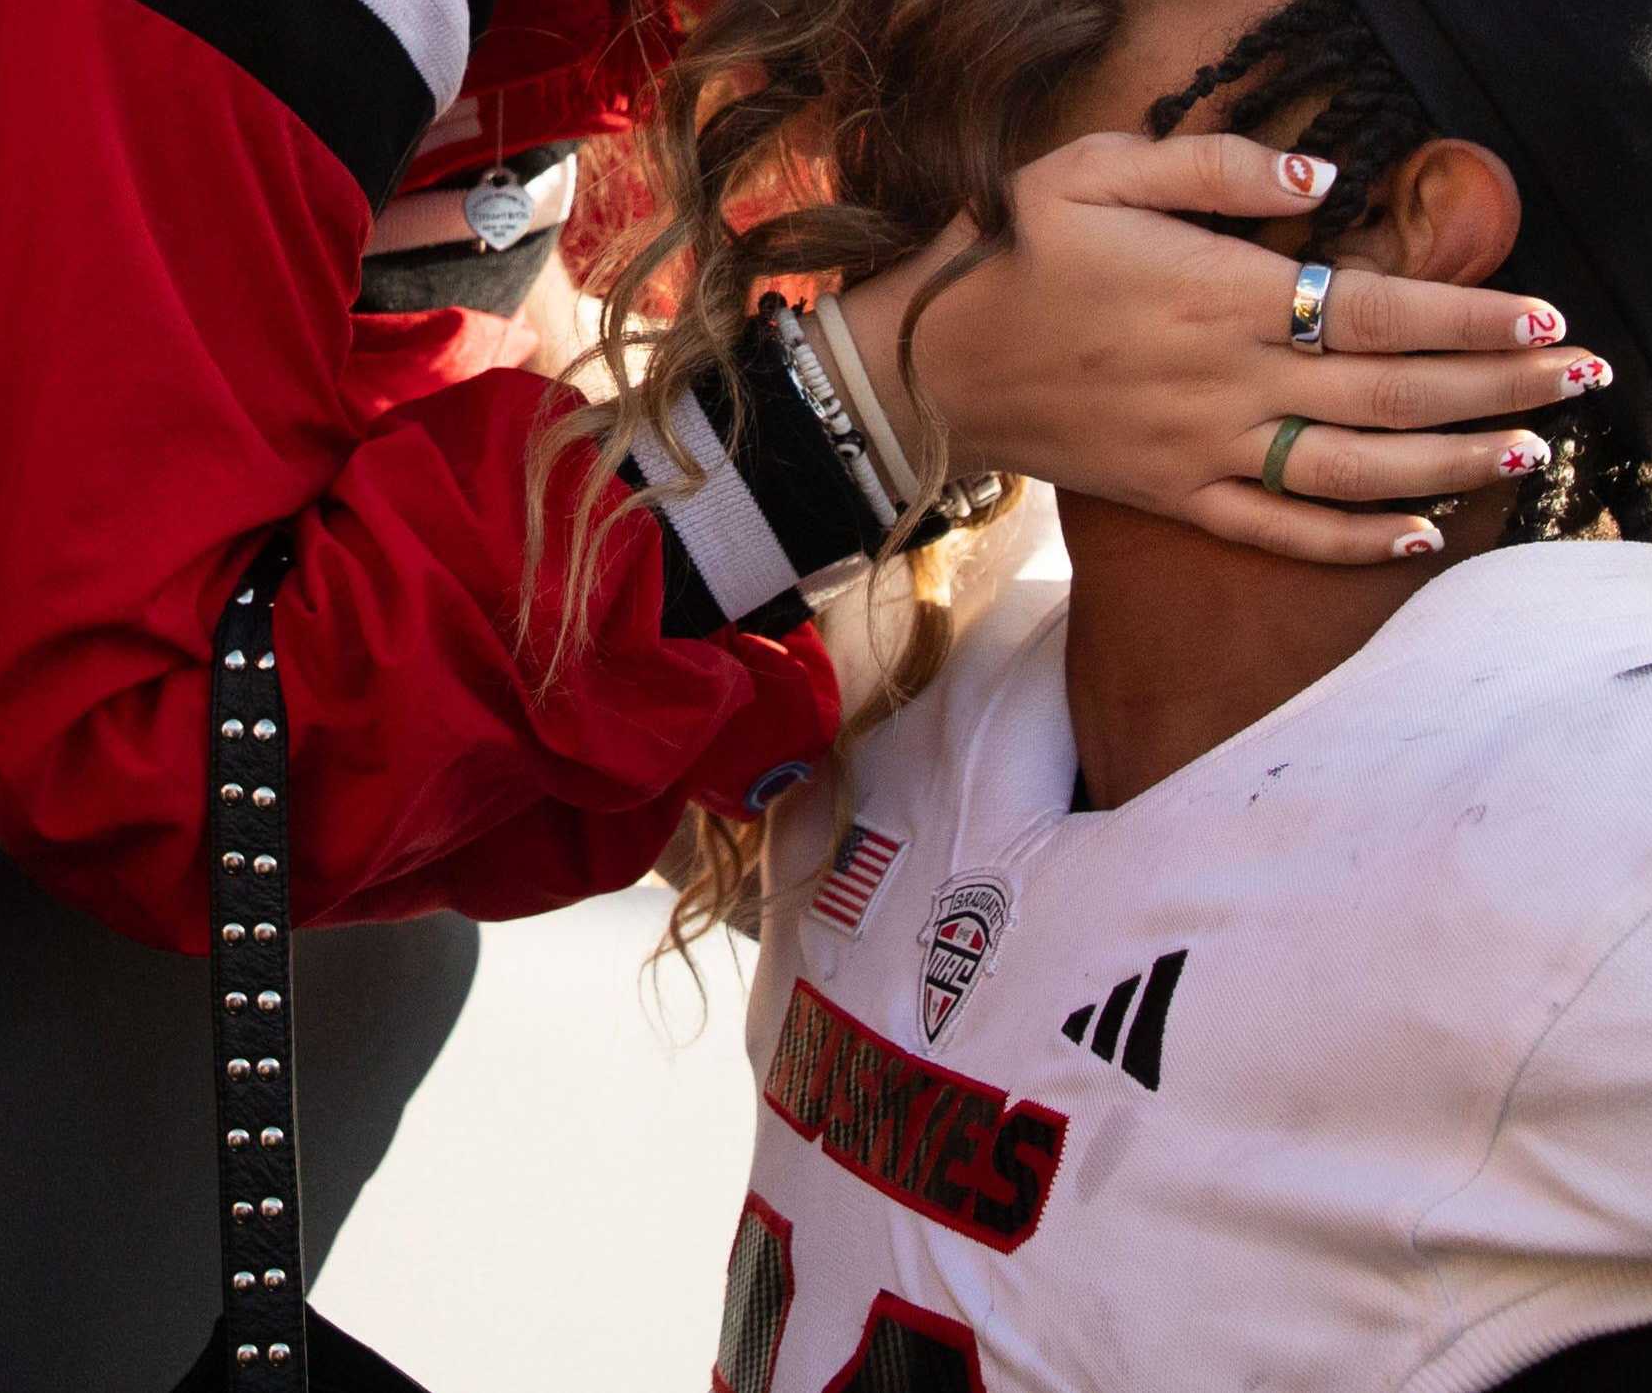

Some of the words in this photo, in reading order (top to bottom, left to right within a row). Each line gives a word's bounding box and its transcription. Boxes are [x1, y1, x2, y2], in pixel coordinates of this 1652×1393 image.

[952, 889, 1003, 928] GRADUATE
[929, 952, 976, 991] MAC
[767, 987, 1061, 1239] HUSKIES
